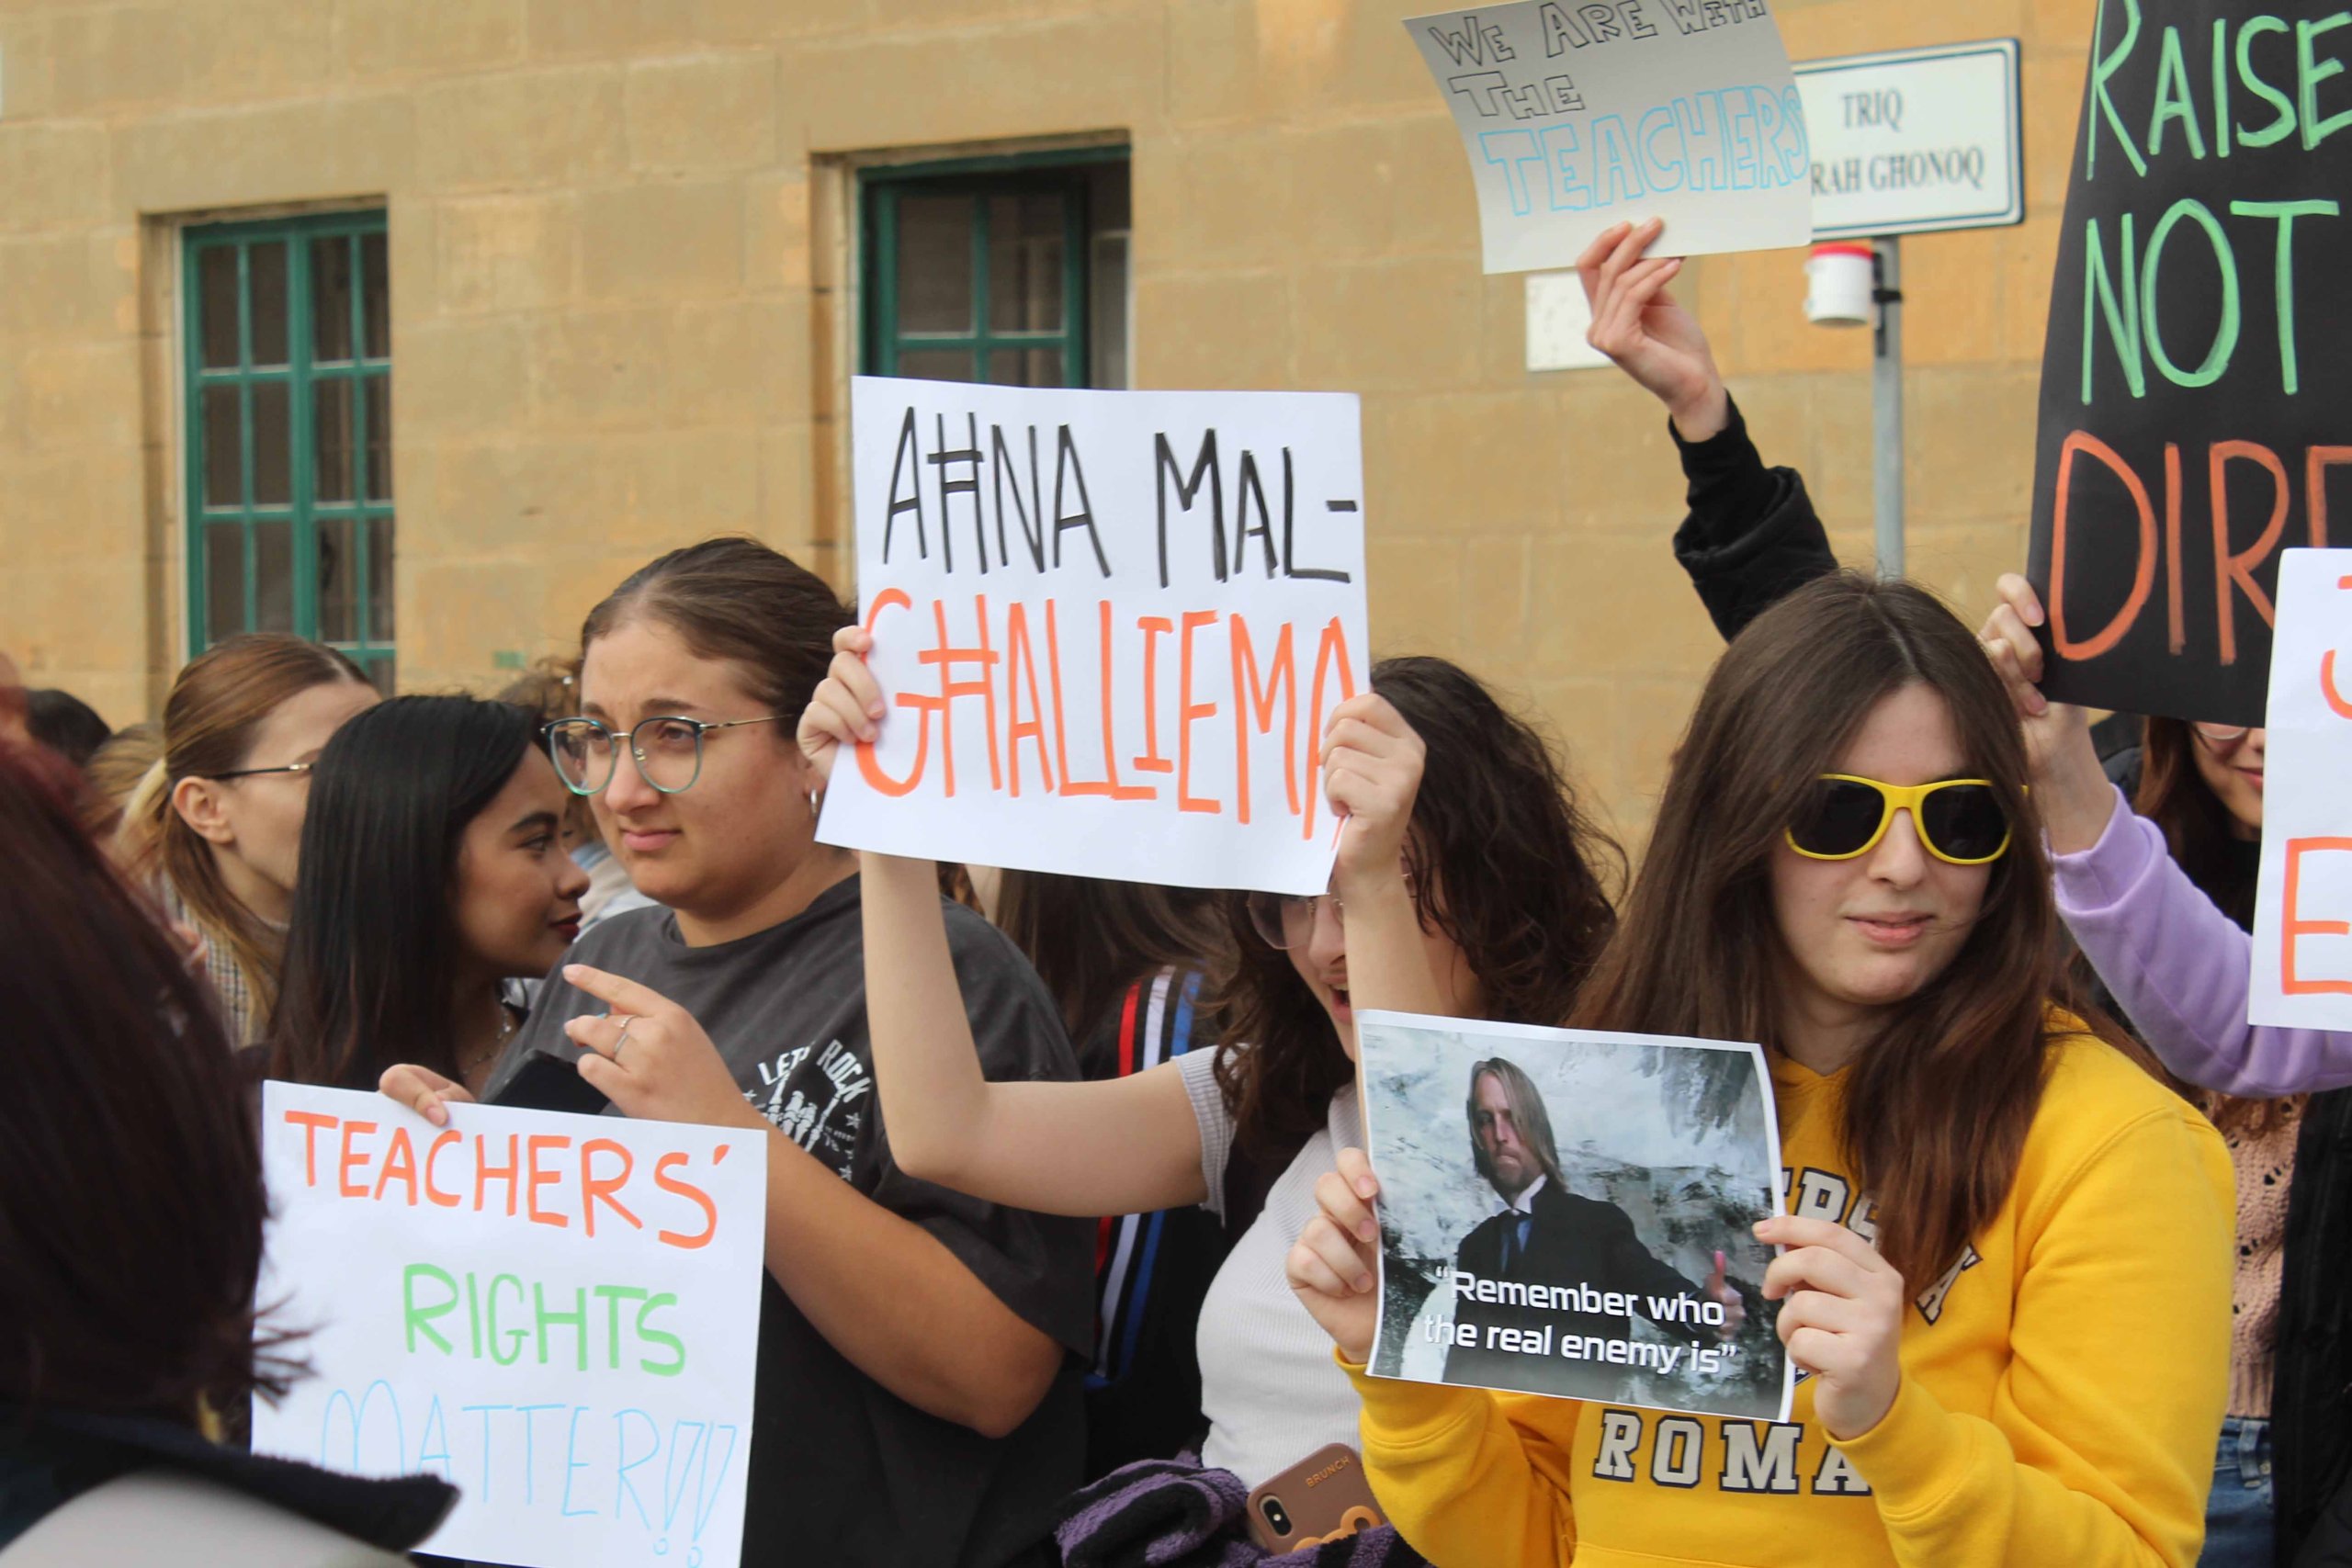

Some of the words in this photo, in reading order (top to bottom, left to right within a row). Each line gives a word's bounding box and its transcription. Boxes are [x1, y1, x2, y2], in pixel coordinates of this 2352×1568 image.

[1428, 16, 1517, 66] WE
[1540, 1, 1658, 58] ARE
[1661, 0, 1767, 36] WITH
[1447, 70, 1587, 120] THE
[1840, 86, 1904, 132] TRIQ
[2086, 0, 2352, 181] RAISE
[1477, 85, 1810, 217] TEACHERS
[2081, 198, 2340, 406] NOT
[1154, 427, 1359, 589] MAL-
[816, 1039, 872, 1103] ROCK
[283, 1110, 730, 1250] TEACHERS'
[403, 1262, 686, 1377] RIGHTS
[1424, 1314, 1477, 1348] the
[1485, 1324, 1554, 1357] real
[1560, 1333, 1681, 1375] enemy
[1646, 1291, 1726, 1326] who
[1305, 1455, 1351, 1489] BRUNCH
[1591, 1407, 1873, 1497] ROMA
